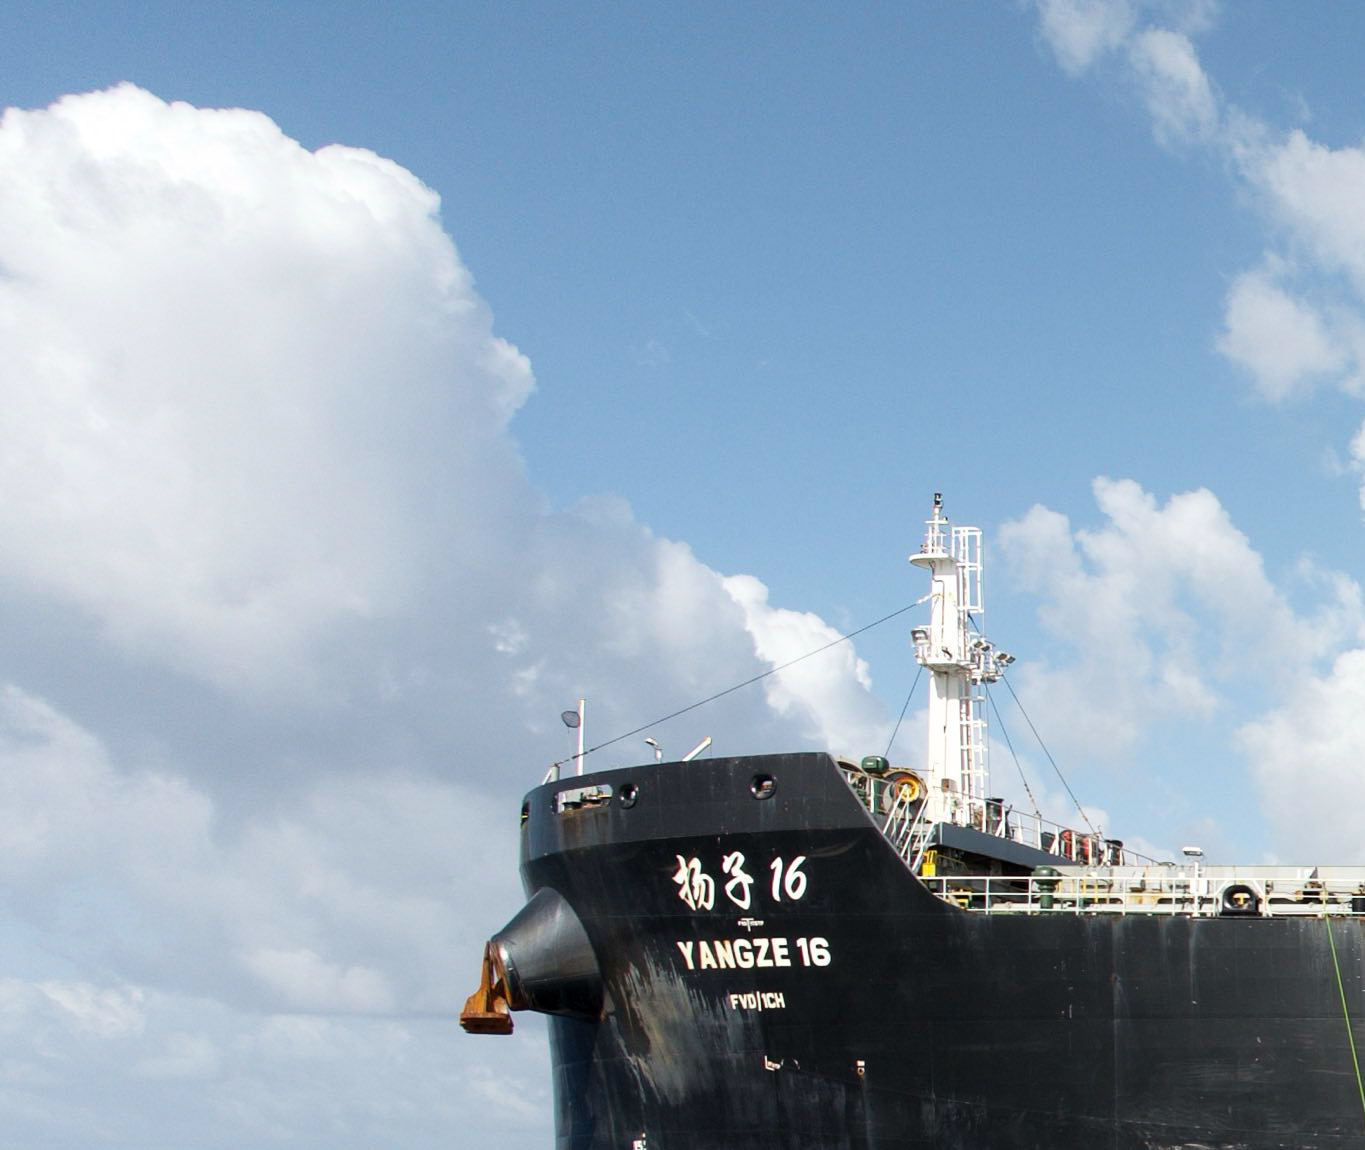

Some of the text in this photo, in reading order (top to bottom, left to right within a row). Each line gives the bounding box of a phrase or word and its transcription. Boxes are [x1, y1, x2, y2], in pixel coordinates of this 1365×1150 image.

[770, 856, 807, 901] 16
[677, 937, 831, 970] YANGZE 16
